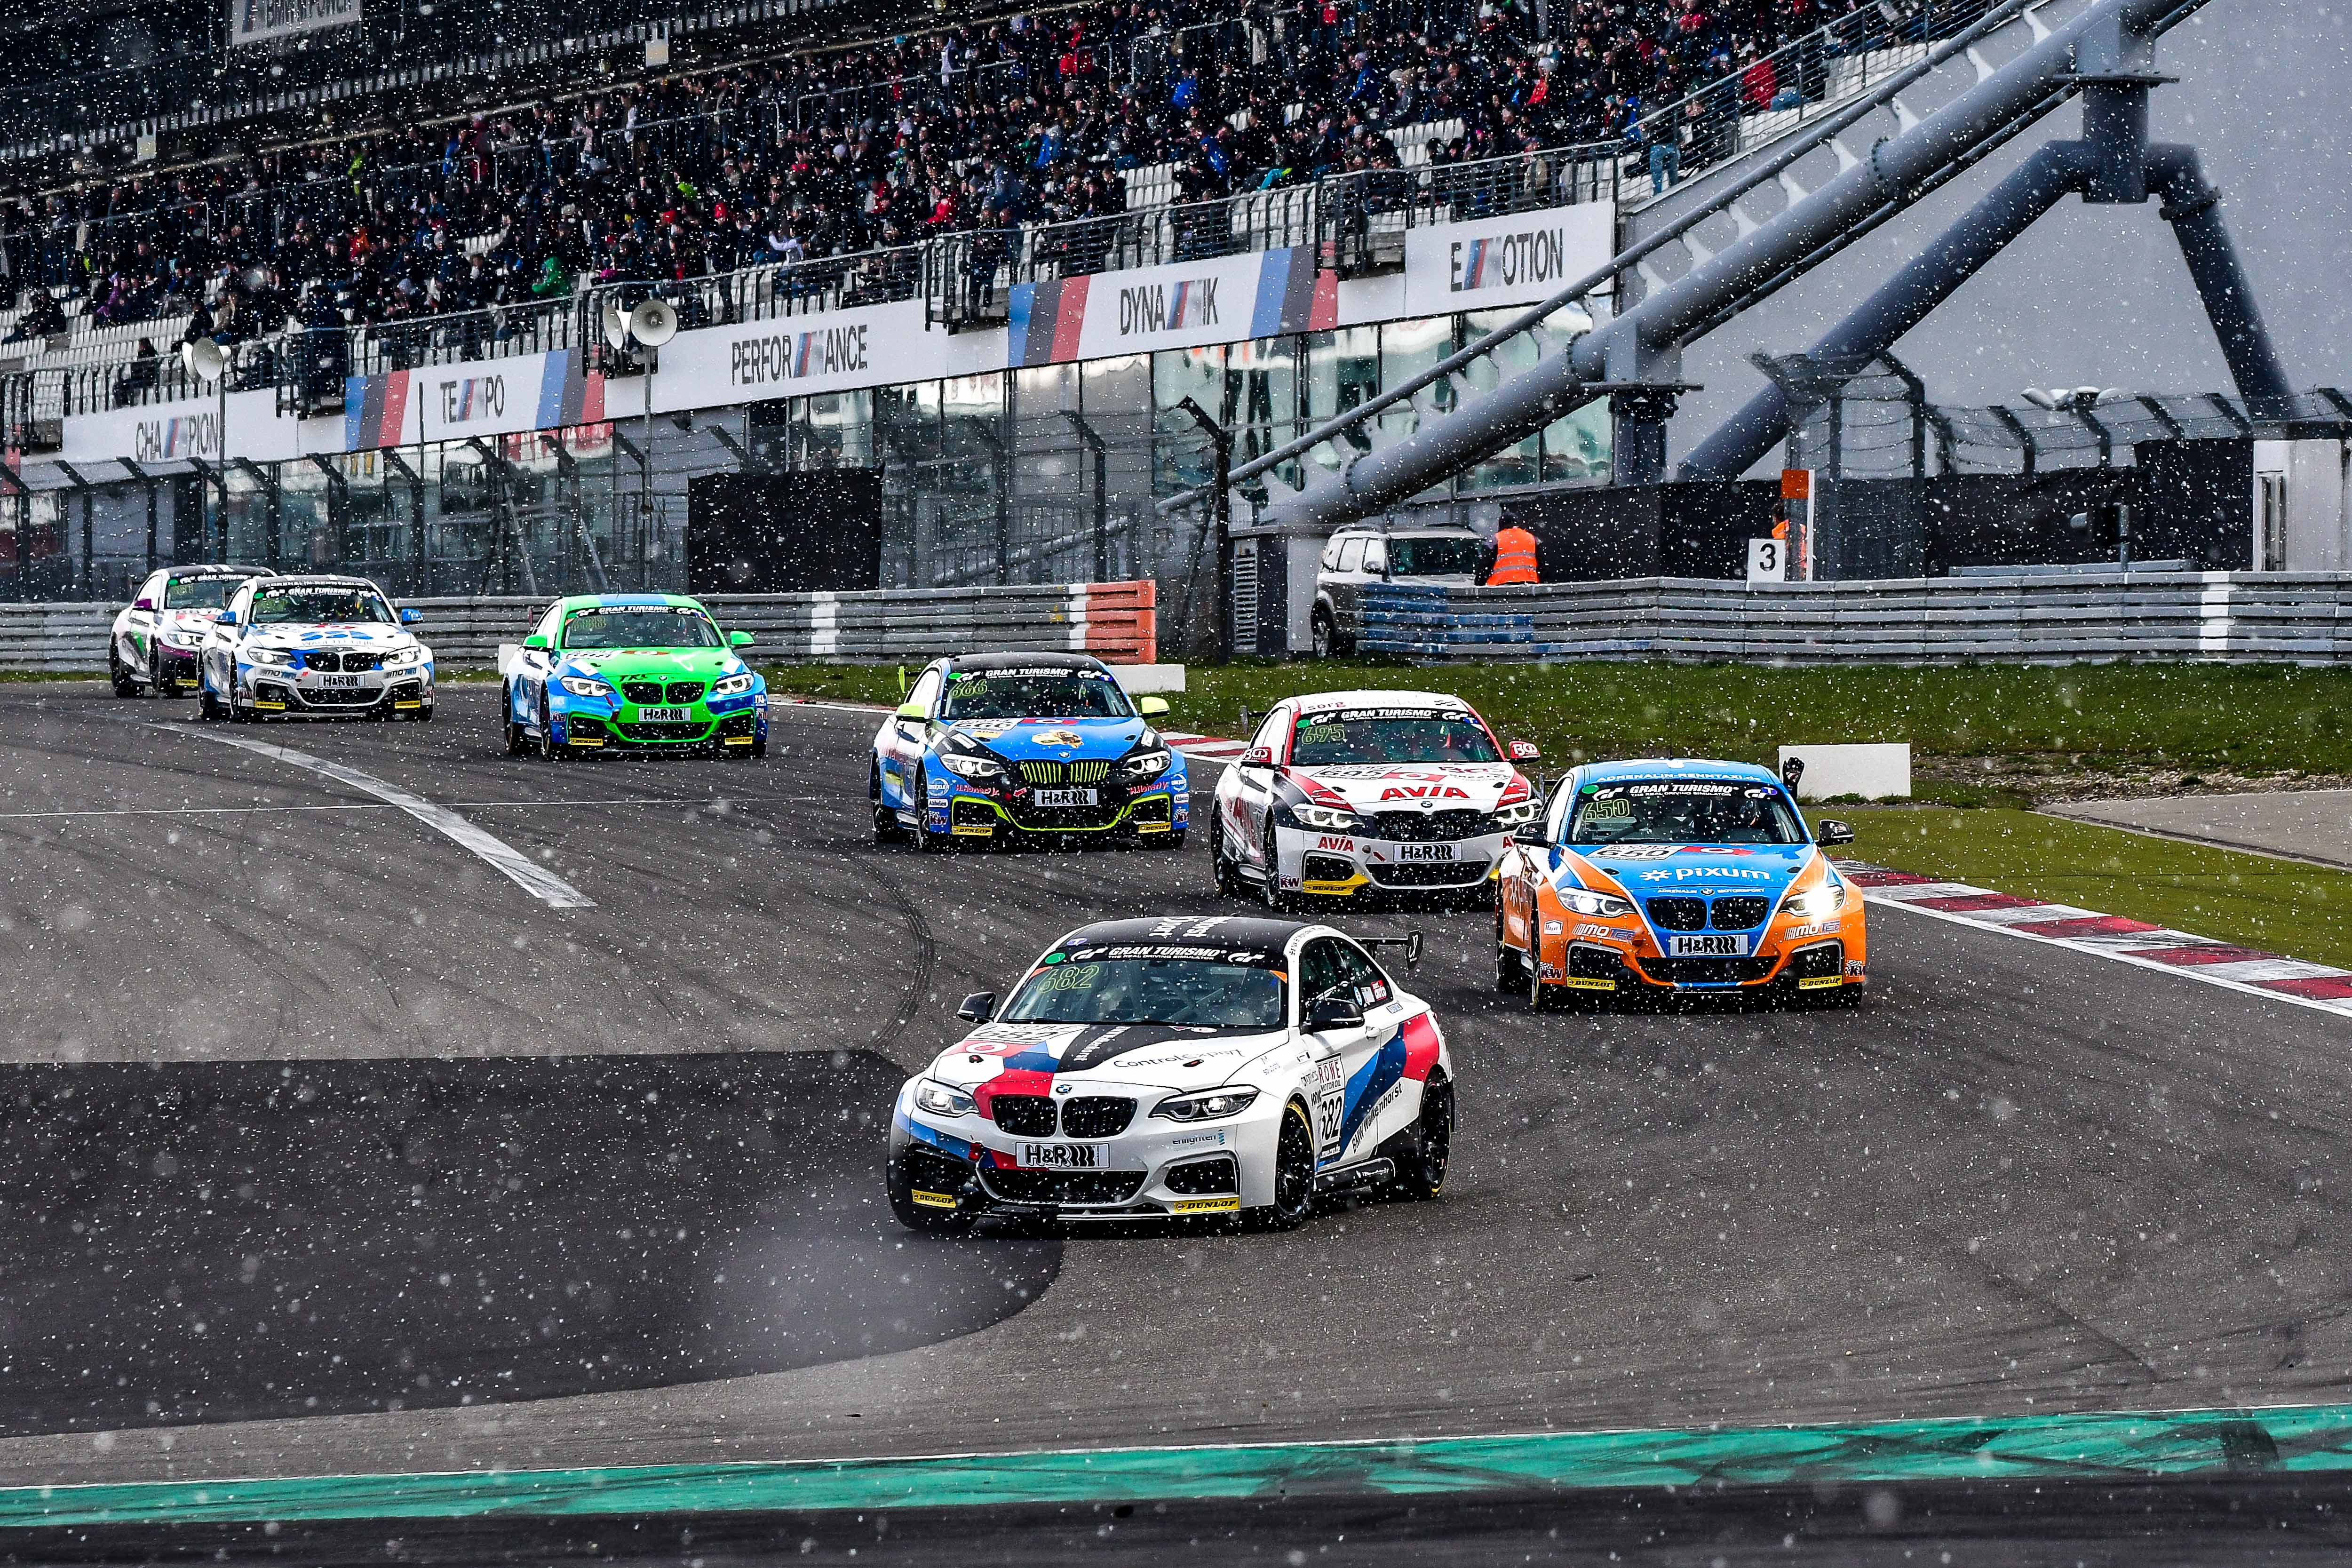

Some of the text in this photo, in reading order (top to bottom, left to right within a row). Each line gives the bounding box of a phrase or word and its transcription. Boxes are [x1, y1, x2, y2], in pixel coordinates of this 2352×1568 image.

[1759, 543, 1776, 571] 3
[950, 680, 987, 698] 666
[1341, 710, 1375, 719] GRAN
[1301, 724, 1345, 745] 695
[1380, 784, 1470, 800] AVIA
[1629, 785, 1669, 794] GRAN
[1672, 784, 1734, 793] TURISMO
[1581, 799, 1630, 821] 650
[1317, 836, 1355, 852] AVIA
[1400, 845, 1434, 860] H&R
[1675, 868, 1770, 881] pixum
[1108, 947, 1149, 956] GRAN
[1152, 947, 1221, 957] TURISMO
[1677, 936, 1717, 955] H&R
[1036, 965, 1100, 994] 682
[1807, 978, 1841, 987] DUNLOP
[1114, 1049, 1246, 1068] ControlExpert
[1319, 1062, 1341, 1083] ROWE
[1320, 1081, 1335, 1092] MOTOR
[1321, 1096, 1342, 1140] 682
[1352, 1081, 1403, 1154] BMW Walkenhorst
[1025, 1144, 1071, 1167] H&R
[919, 1194, 954, 1204] DUNLOP
[1186, 1200, 1237, 1209] DUNLOP
